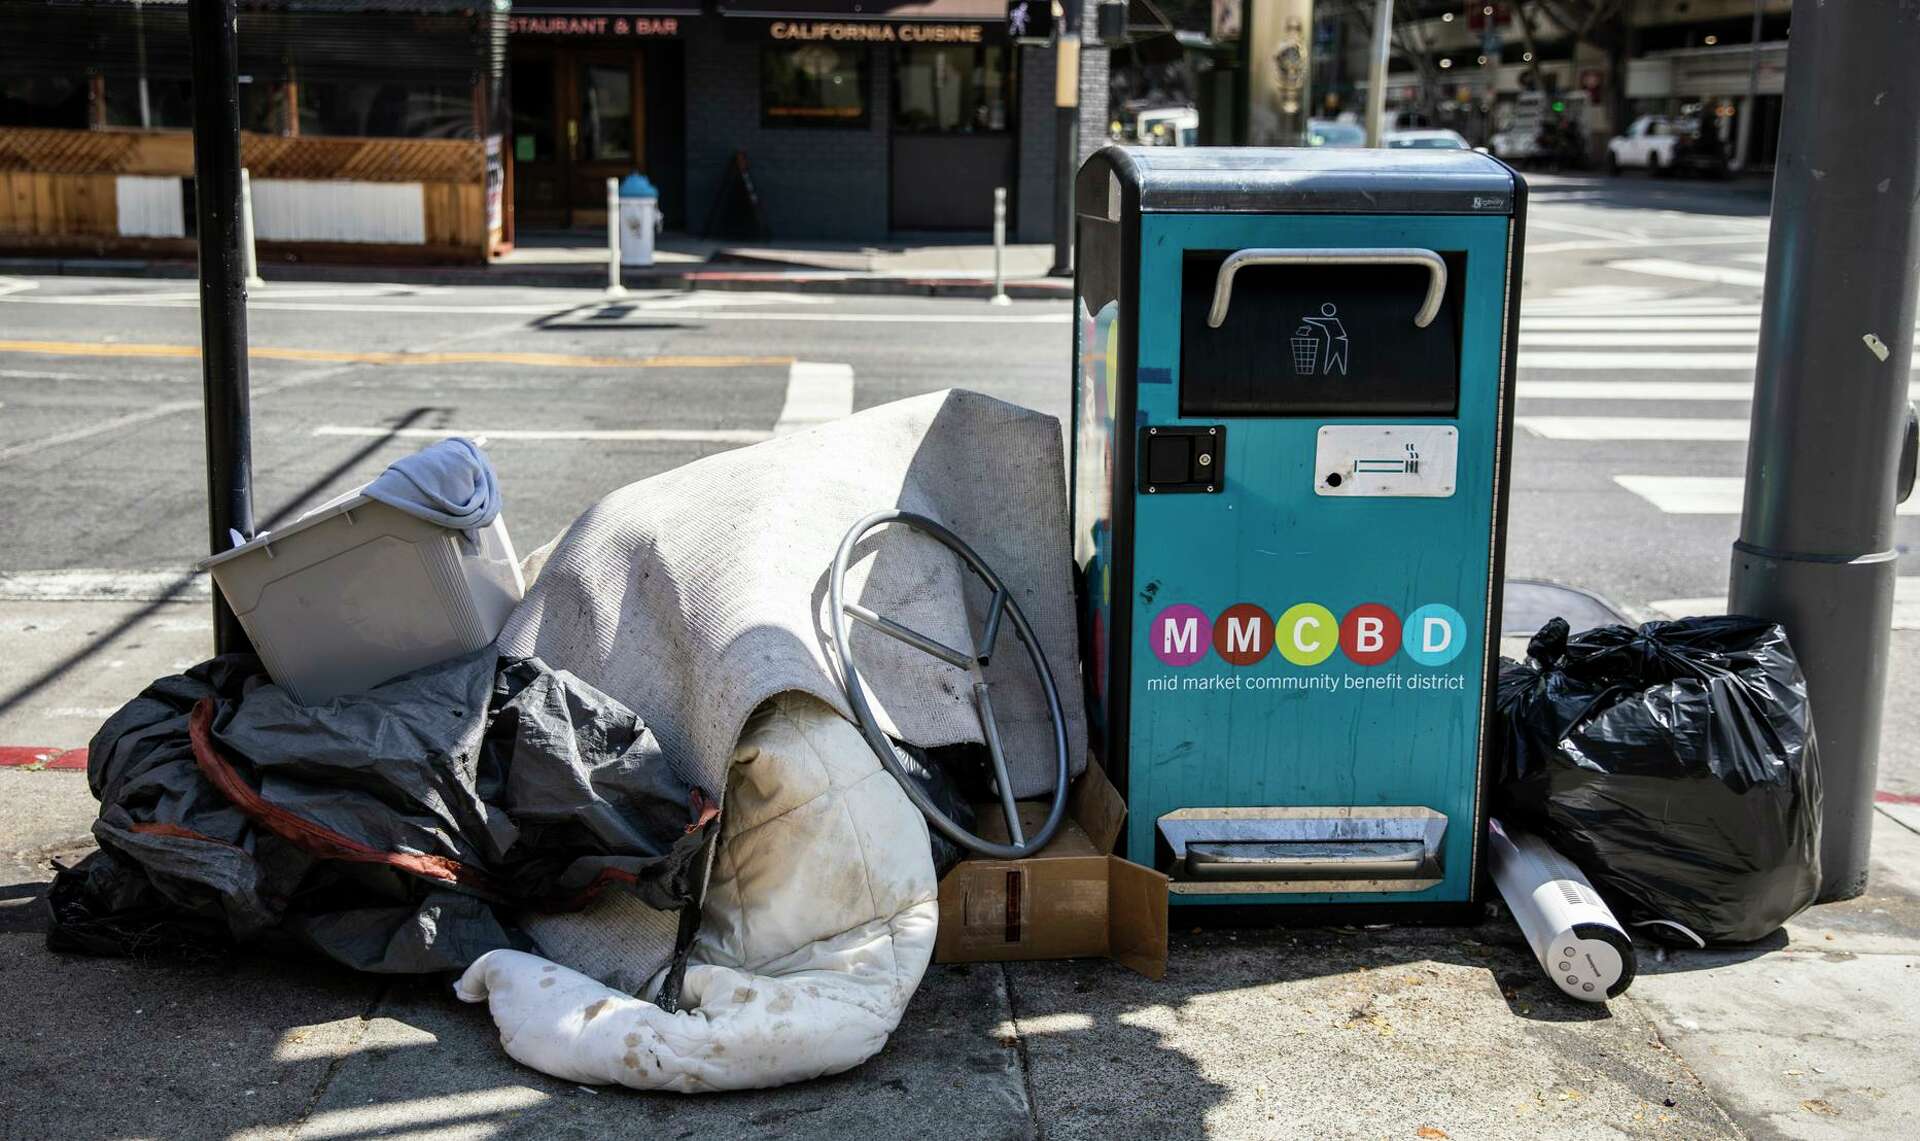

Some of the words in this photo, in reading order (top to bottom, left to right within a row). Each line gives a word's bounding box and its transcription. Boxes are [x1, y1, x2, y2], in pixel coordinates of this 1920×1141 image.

[614, 18, 629, 35] &
[635, 18, 678, 35] BAR
[770, 22, 896, 41] CALIFORNIA
[898, 24, 983, 42] CUISINE
[1147, 675, 1178, 690] mid
[1183, 674, 1241, 690] market
[1245, 673, 1340, 693] community
[1344, 673, 1402, 690] benefit
[1406, 673, 1465, 690] district
